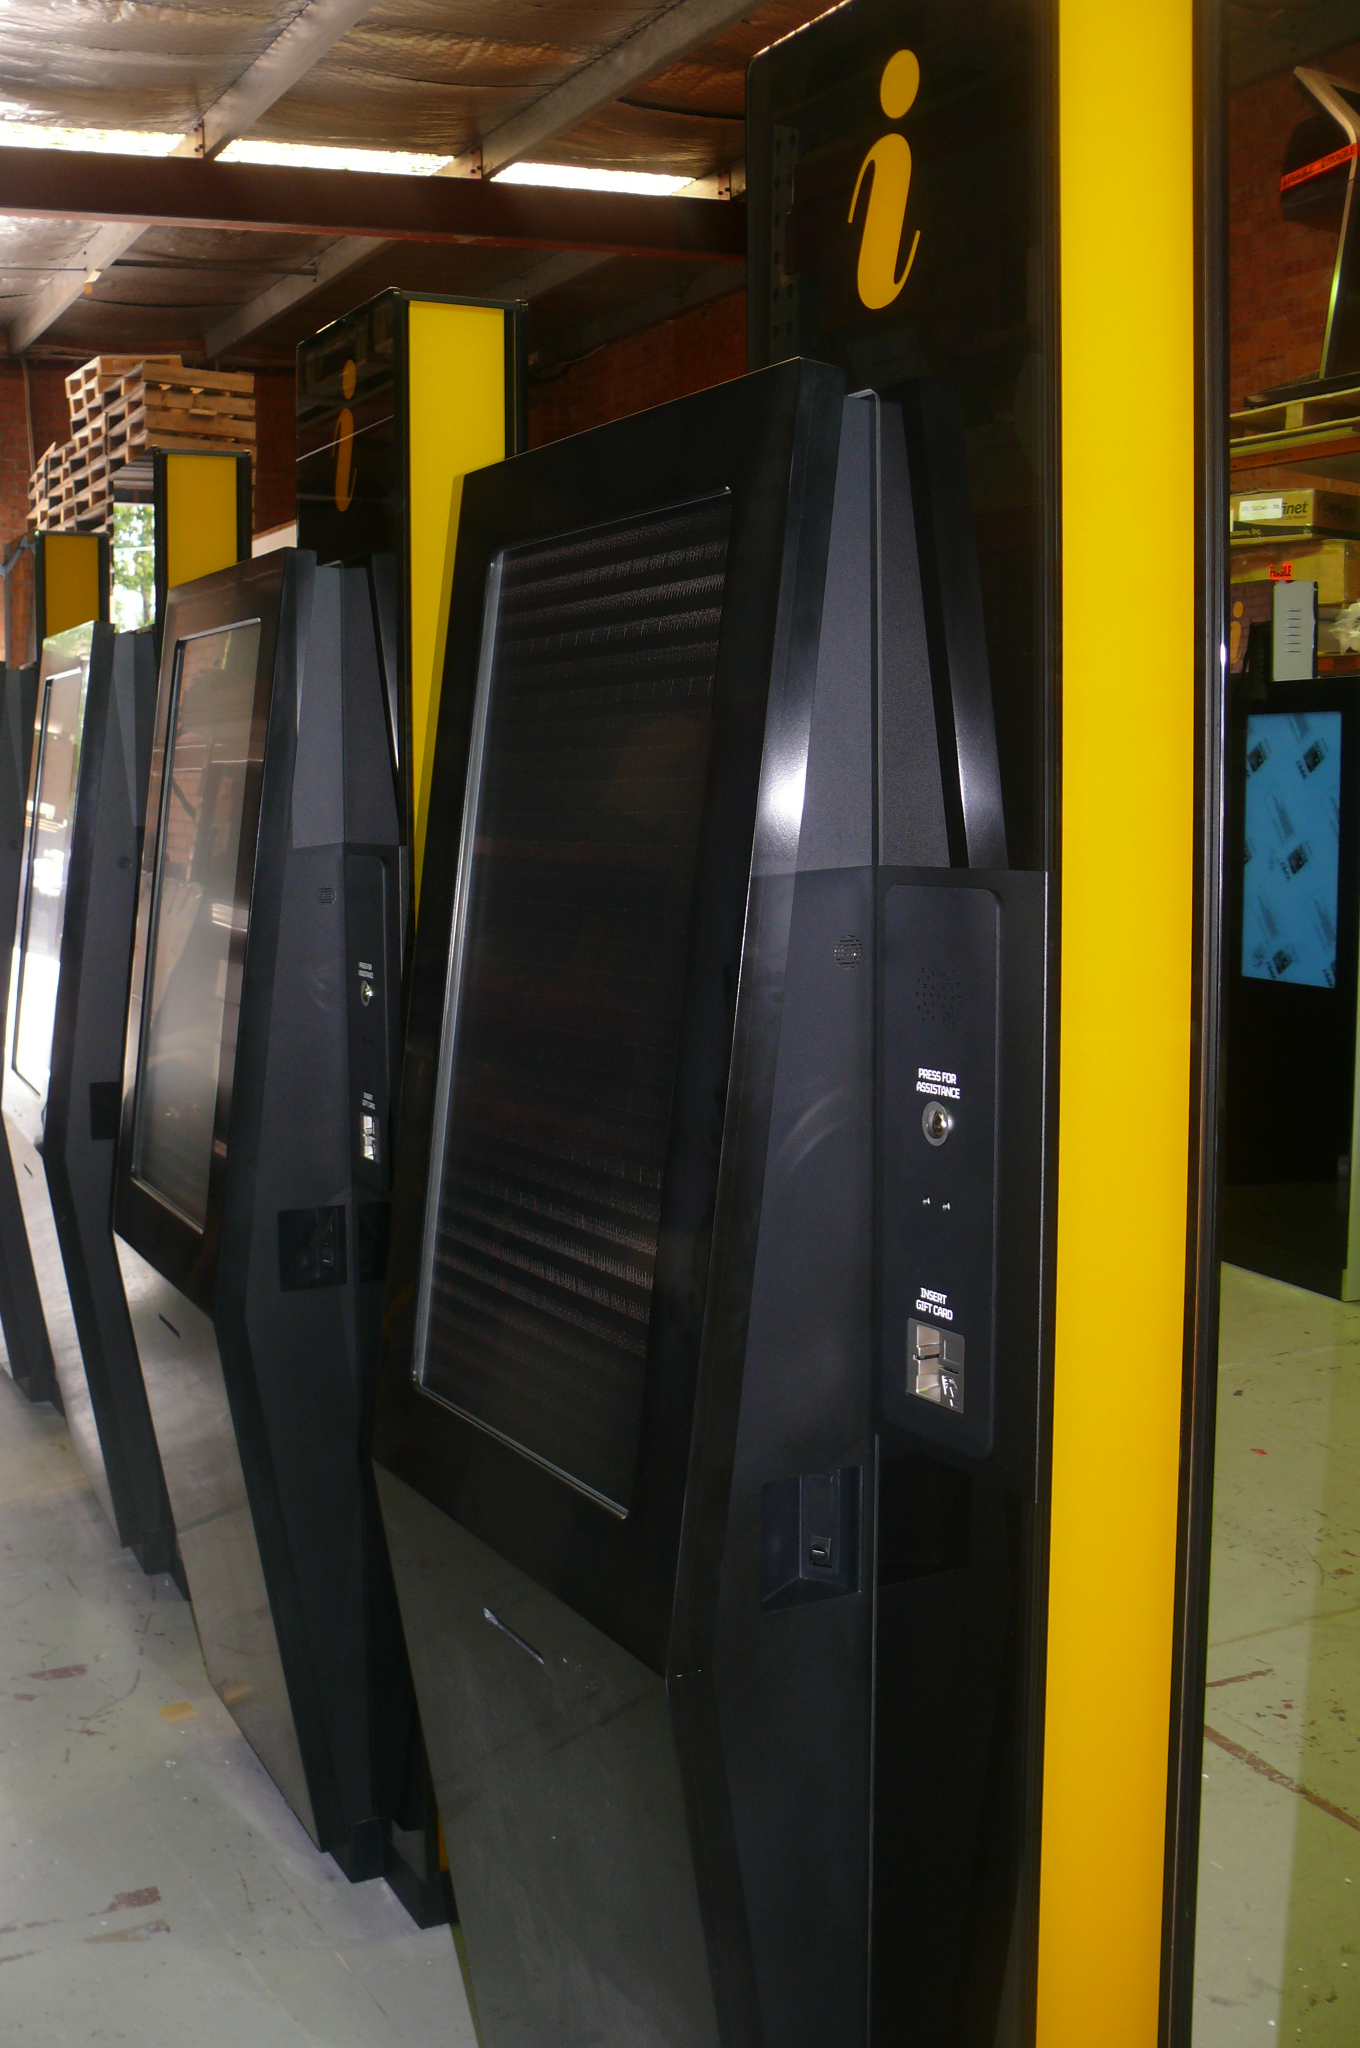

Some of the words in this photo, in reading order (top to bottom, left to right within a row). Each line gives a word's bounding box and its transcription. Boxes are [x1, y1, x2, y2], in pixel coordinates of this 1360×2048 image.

[918, 1067, 941, 1082] PRESS
[941, 1072, 957, 1084] FOR
[915, 1081, 960, 1099] ASSISTANCE
[920, 1287, 947, 1305] INSERT
[915, 1299, 933, 1313] GIFT
[933, 1304, 953, 1320] CARD
